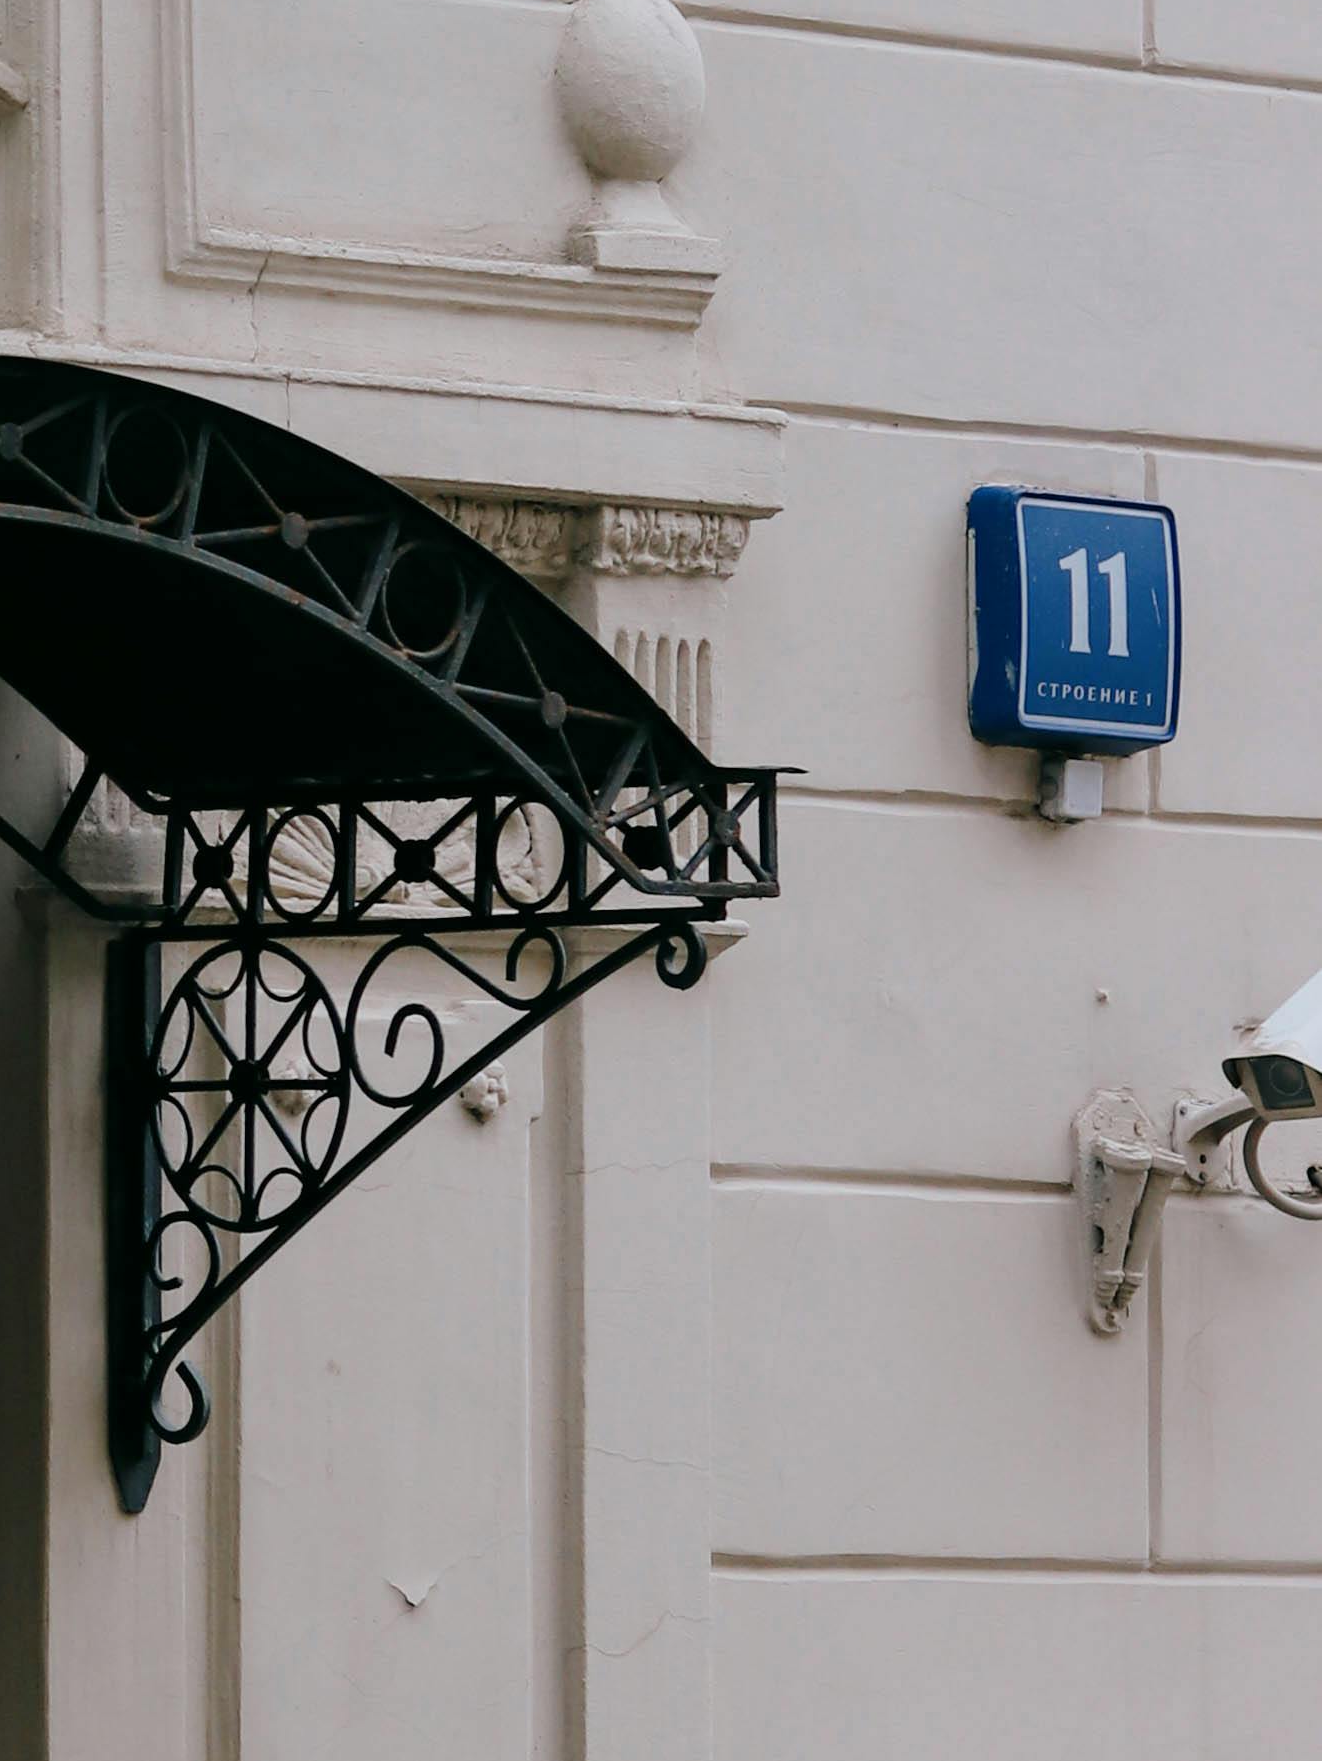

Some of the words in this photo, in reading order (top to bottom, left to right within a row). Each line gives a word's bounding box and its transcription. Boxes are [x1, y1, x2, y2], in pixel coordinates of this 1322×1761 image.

[1059, 547, 1130, 657] 11
[1037, 681, 1138, 706] СТРОЕНИЕ
[1145, 692, 1153, 707] 1
